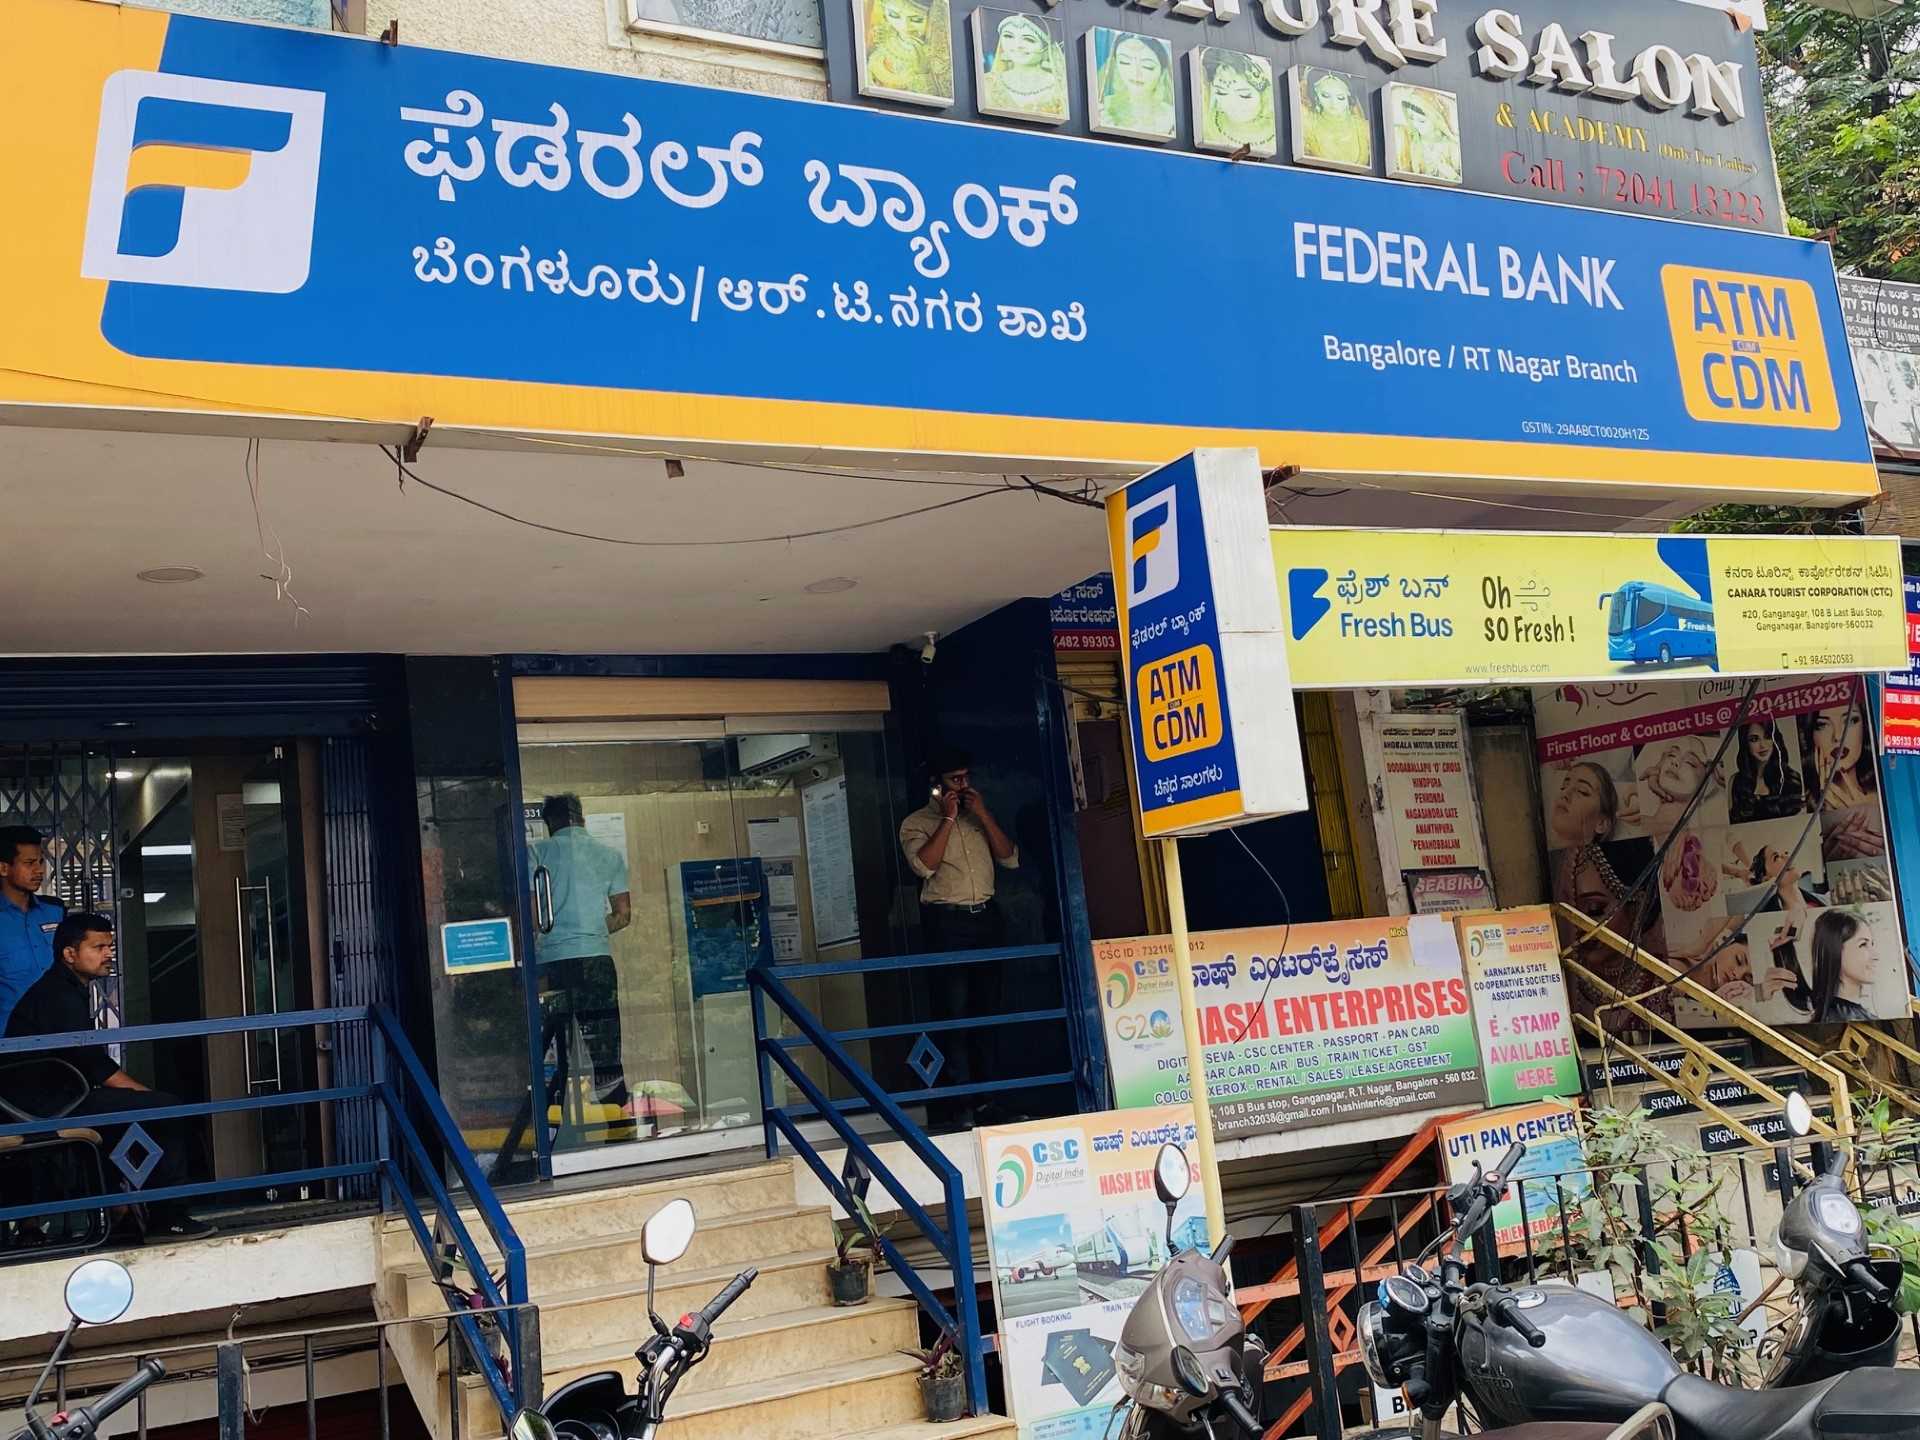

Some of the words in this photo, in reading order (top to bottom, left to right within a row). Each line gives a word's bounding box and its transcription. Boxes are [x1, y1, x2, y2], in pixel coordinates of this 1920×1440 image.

[1474, 9, 1745, 123] SALON
[1495, 102, 1516, 128] &
[1528, 108, 1650, 153] ACADEMY
[400, 89, 765, 209] ಫೆಡರಲ್
[803, 158, 1080, 279] ಬ್ಯಾಂಕ್
[1501, 151, 1566, 193] Call
[1575, 171, 1585, 196] :
[1596, 166, 1678, 210] 72041
[1689, 182, 1766, 224] 13223
[1293, 221, 1490, 297] FEDERAL
[1498, 244, 1625, 311] BANK
[996, 300, 1089, 342] ಶಾಖೆ
[1692, 277, 1797, 341] ATM
[1323, 333, 1442, 371] Bangalore
[1448, 344, 1456, 370] /
[1462, 345, 1491, 372] RT
[1497, 348, 1561, 383] Nagar
[1567, 353, 1639, 384] Branch
[1702, 352, 1812, 414] CDM
[1521, 420, 1555, 435] GSTIN:
[1399, 574, 1450, 599] ಬಸ್
[1482, 575, 1511, 610] Oh
[1727, 588, 1767, 598] CANARA
[1768, 587, 1806, 598] TOURIST
[1808, 586, 1869, 597] CORPORATION
[1870, 586, 1893, 598] (CTC)
[1131, 617, 1169, 648] ಫೆಡರಲ್
[1170, 601, 1207, 636] ಬ್ಯಾಂಕ್
[1341, 611, 1405, 638] Fresh
[1410, 613, 1454, 638] Bus
[1833, 608, 1849, 617] Last
[1850, 607, 1864, 617] Bus
[1082, 635, 1115, 648] 99303
[1464, 662, 1551, 674] www.freshbus.com
[1794, 655, 1808, 665] +91
[1150, 655, 1201, 705] ATM
[1152, 703, 1208, 751] CDM
[1546, 738, 1579, 757] First
[1579, 729, 1618, 750] Floor
[1619, 729, 1631, 742] &
[1633, 717, 1693, 740] Contact
[1694, 711, 1714, 728] Us
[1715, 707, 1732, 724] @
[1416, 875, 1484, 893] SEABIRD
[1483, 928, 1502, 940] CSC
[1100, 950, 1121, 961] CSC
[1123, 947, 1134, 958] ID
[1133, 958, 1169, 977] CSC
[1484, 965, 1525, 978] KARNATAKA
[1526, 962, 1547, 974] STATE
[1524, 973, 1561, 987] SOCIETIES
[1274, 977, 1468, 1037] ENTERPRISES
[1491, 987, 1538, 1002] ASSOCIATION
[1511, 1011, 1561, 1036] STAMP
[1205, 1049, 1236, 1064] SEVA
[1244, 1046, 1267, 1059] CSC
[1269, 1041, 1315, 1057] CENTER
[1323, 1031, 1379, 1049] PASSPORT
[1387, 1029, 1409, 1041] PAN
[1410, 1024, 1440, 1037] CARD
[1490, 1037, 1571, 1065] AVAILABLE
[1228, 1063, 1261, 1078] CARD
[1269, 1058, 1289, 1071] AIR
[1296, 1056, 1320, 1069] BUS
[1327, 1049, 1360, 1064] TRAIN
[1363, 1045, 1399, 1060] TICKET
[1407, 1041, 1429, 1054] GST
[1208, 1083, 1249, 1097] XEROX
[1256, 1075, 1301, 1089] RENTAL
[1306, 1069, 1344, 1084] SALES
[1351, 1063, 1388, 1078] LEASE
[1387, 1053, 1453, 1073] AGREEMENT
[1517, 1066, 1556, 1088] HERE
[1219, 1105, 1236, 1116] 108
[1237, 1104, 1245, 1115] B
[1246, 1102, 1265, 1113] Bus
[1267, 1097, 1291, 1110] stop,
[1348, 1085, 1366, 1098] R.T.
[1367, 1082, 1395, 1096] Nagar,
[1396, 1076, 1439, 1092] Bangalore
[1444, 1073, 1460, 1083] 560
[1708, 1085, 1742, 1101] SALON
[1032, 1138, 1079, 1164] CSC
[1448, 1133, 1476, 1158] UTI
[1480, 1125, 1512, 1151] PAN
[1064, 1167, 1084, 1178] India
[1099, 1170, 1134, 1196] HASH
[1015, 1317, 1040, 1329] FLIGHT
[1041, 1311, 1072, 1326] BOOKING
[1102, 1302, 1122, 1313] TRAIN
